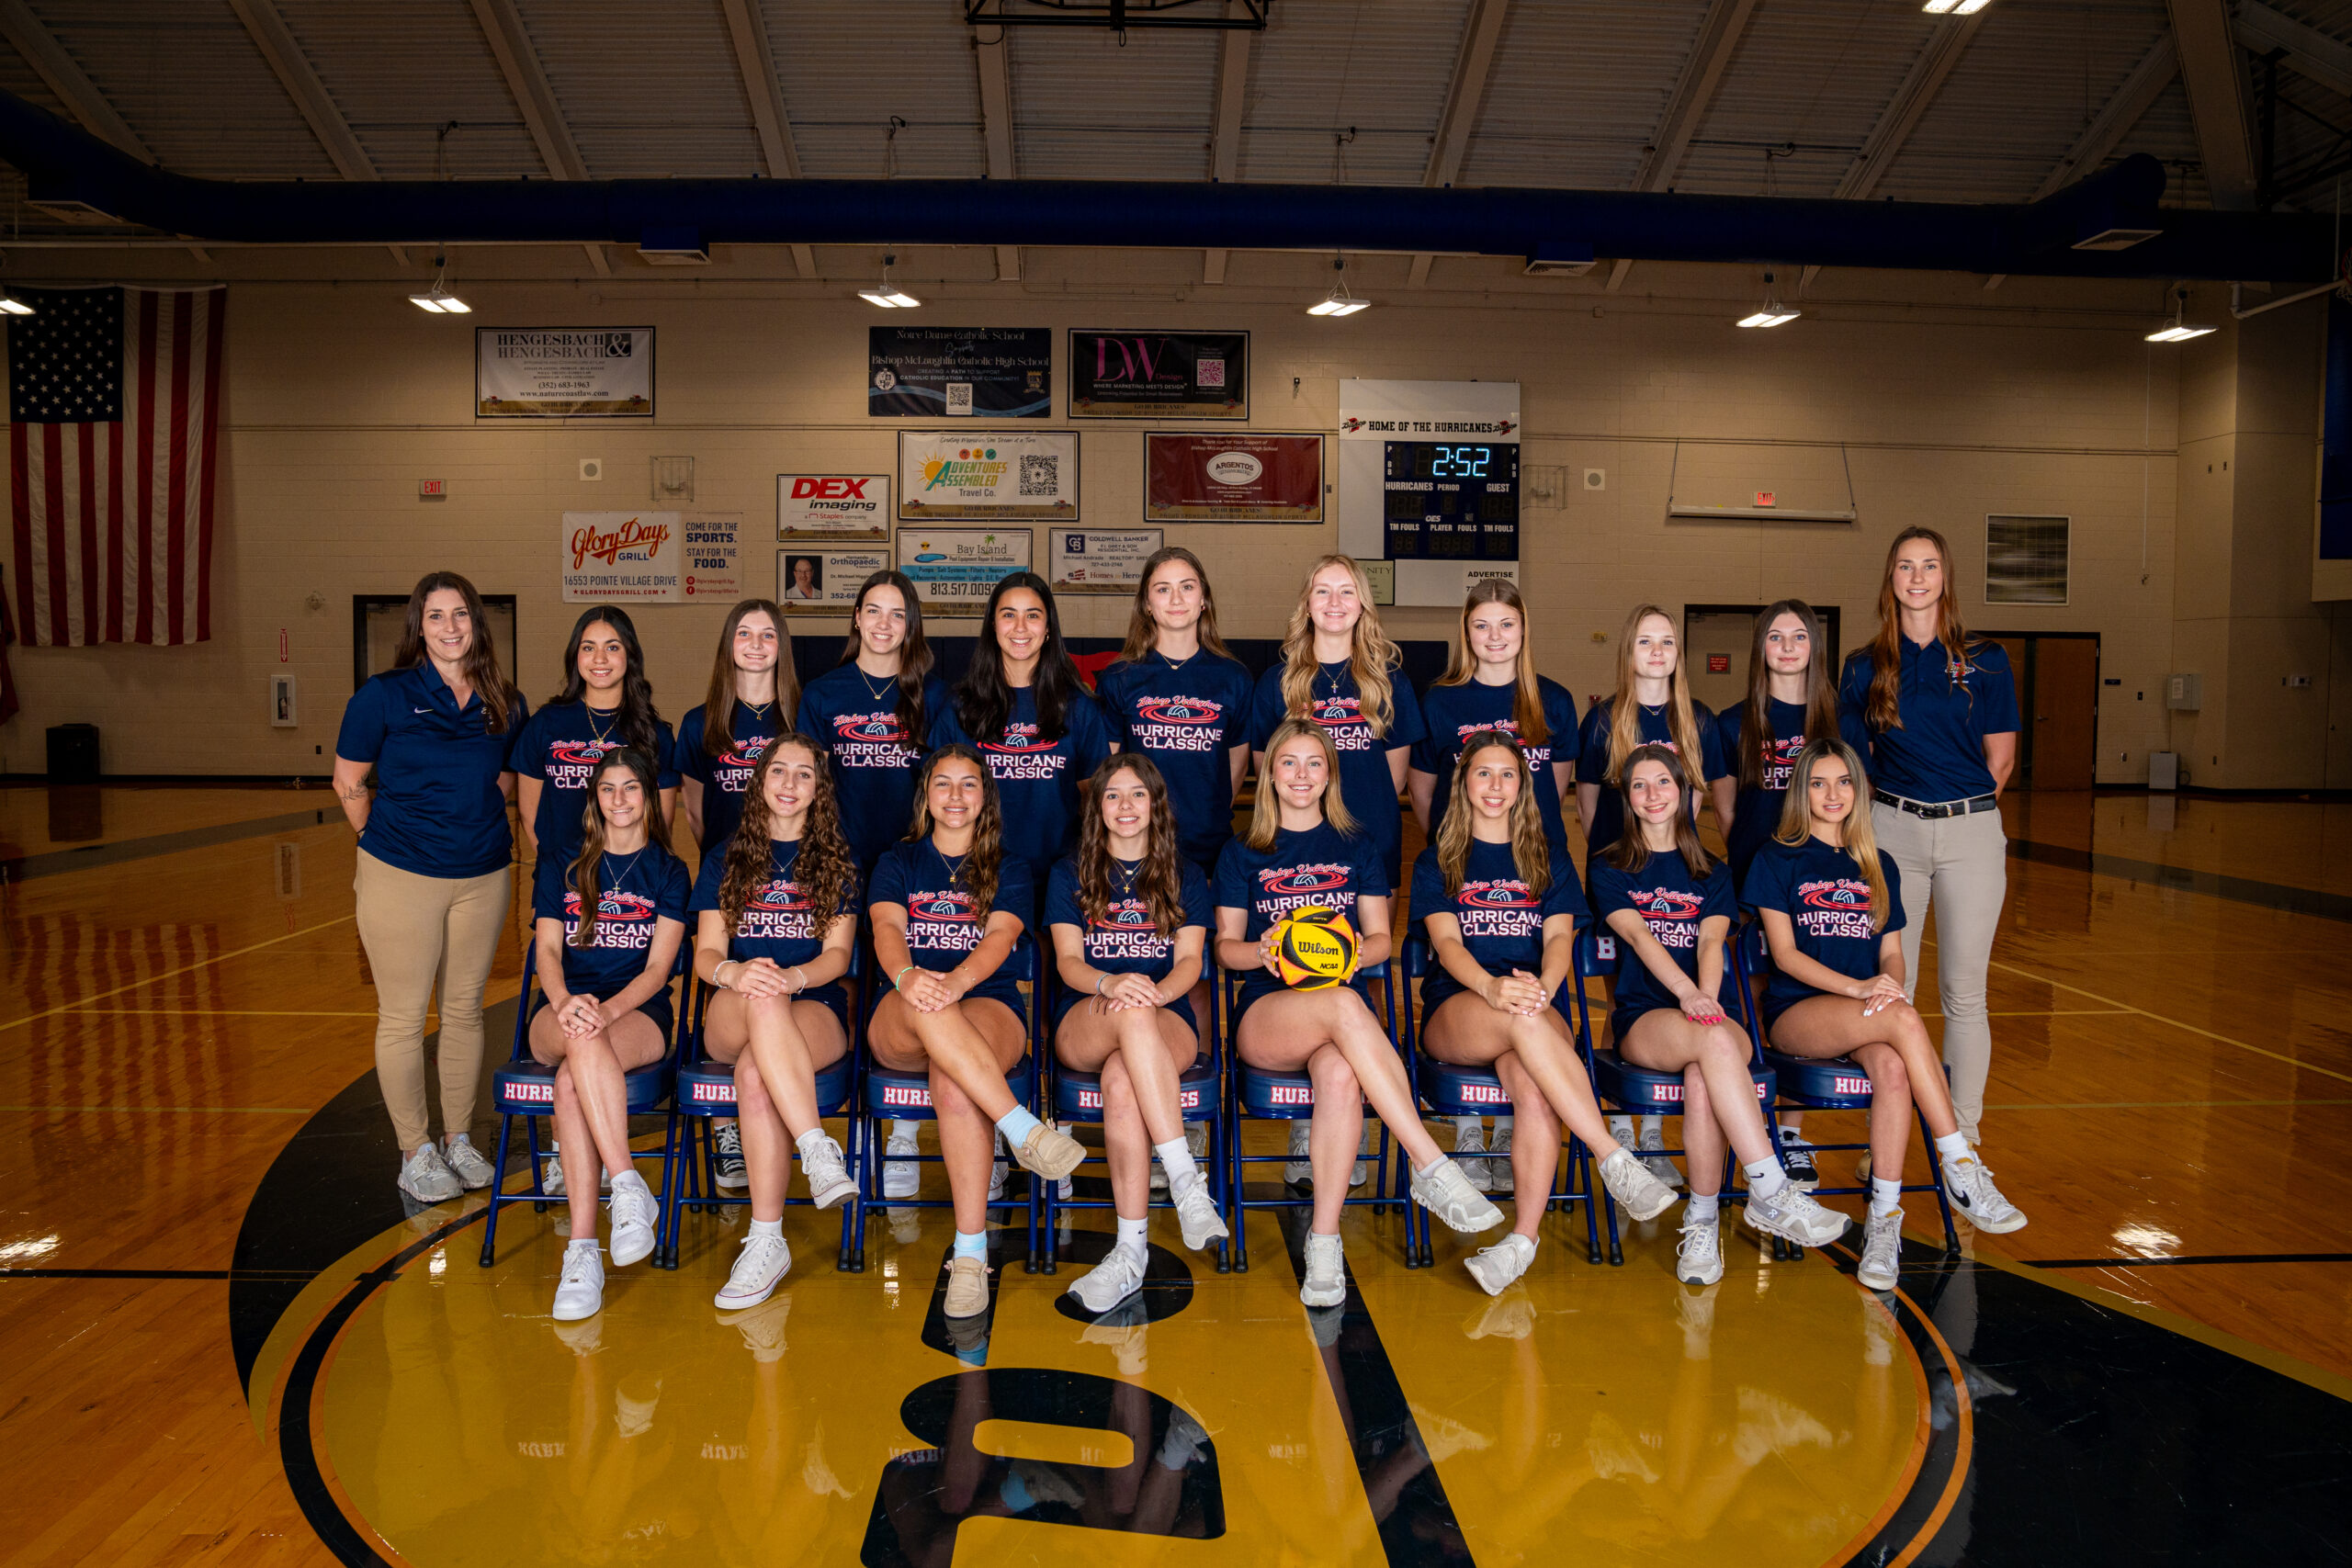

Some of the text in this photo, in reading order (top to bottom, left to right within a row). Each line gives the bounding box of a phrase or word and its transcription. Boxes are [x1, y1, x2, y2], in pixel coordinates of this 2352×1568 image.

[924, 330, 953, 339] Dame
[954, 330, 990, 340] Catholic
[992, 331, 1024, 340] School
[497, 333, 630, 357] HENGESBACH &
[498, 346, 604, 358] HENGESBACH
[872, 355, 1049, 367] Bishop McLaughlin Catholic High School
[1155, 373, 1182, 382] Design
[538, 381, 590, 389] (352) 683-1963
[519, 389, 609, 398] www.naturecoastlaw.com
[1369, 421, 1493, 433] HOME OF THE HURRICANES
[1216, 462, 1254, 472] ARGENTOS
[1432, 446, 1490, 477] 2:52
[424, 480, 441, 493] EXIT
[790, 478, 870, 499] DEX
[1385, 481, 1433, 491] HURRICANES
[1437, 483, 1460, 491] PERIOD
[1486, 483, 1510, 492] GUEST
[959, 488, 996, 497] Travel Co.
[1757, 491, 1772, 505] EXIT
[809, 499, 876, 511] imaging
[820, 513, 843, 521] Staples
[685, 522, 738, 531] COME FOR THE
[1389, 523, 1419, 532] TM FOULS
[1430, 524, 1477, 532] PLAYER FOULS
[1484, 525, 1514, 533] TM FOULS
[571, 517, 672, 570] Glory Days
[686, 532, 737, 543] SPORTS.
[686, 548, 737, 558] STAY FOR THE
[957, 543, 1007, 556] Bay Island
[618, 552, 650, 561] GRILL
[830, 558, 880, 567] Orthopaedic
[694, 558, 729, 569] FOOD.
[564, 575, 677, 586] 16553 POINTE VILLAGE DRIVE
[1122, 571, 1142, 580] Hero
[1136, 694, 1224, 713] Bishop Volleyball
[1327, 695, 1362, 708] Volley
[833, 714, 869, 727] Bishop
[1131, 724, 1224, 741] HURRICANE
[1457, 723, 1493, 737] Bishop
[1142, 736, 1213, 751] CLASSIC
[1335, 739, 1371, 750] SSIC
[842, 755, 910, 769] CLASSIC
[545, 764, 594, 778] HURRI
[992, 766, 1054, 780] LASSIC
[1258, 862, 1351, 883] Bishop Volleyball
[1462, 879, 1490, 893] ishop
[1798, 878, 1872, 897] Bishop Volley
[1256, 891, 1356, 913] HURRICANE
[1654, 886, 1704, 906] Volleyball
[1462, 922, 1532, 938] CLASSIC
[1654, 932, 1694, 949] ASSIC
[1091, 945, 1168, 959] CLASSIC
[1298, 941, 1340, 955] Wilson
